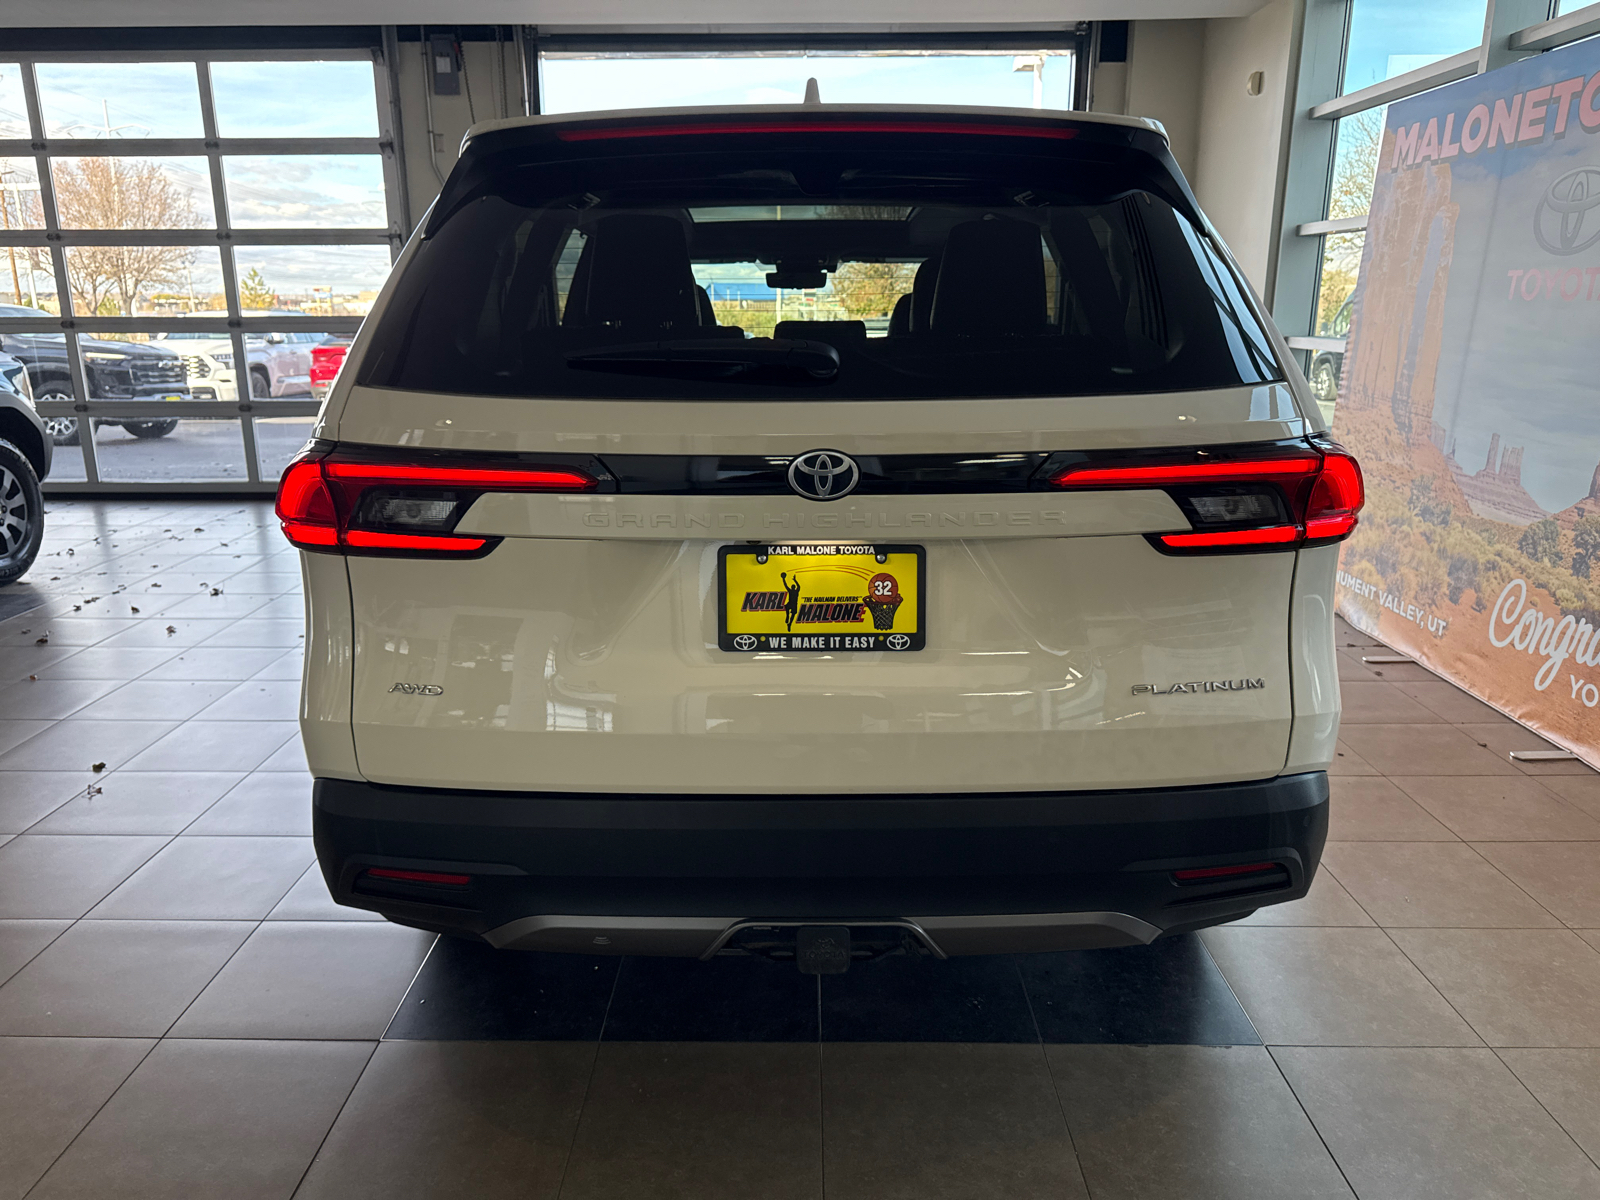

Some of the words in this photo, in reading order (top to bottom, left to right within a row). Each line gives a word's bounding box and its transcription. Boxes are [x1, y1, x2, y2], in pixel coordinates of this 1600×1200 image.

[1507, 266, 1600, 302] TOYOT
[583, 512, 745, 529] GRAND
[763, 510, 1067, 529] HIGHLANDER
[767, 546, 794, 555] KARL
[796, 546, 838, 555] MALONE
[839, 546, 875, 555] TOYOTA
[874, 581, 892, 596] 32
[741, 591, 788, 612] KARL
[796, 603, 866, 623] MALONE
[1379, 590, 1424, 629] VALLEY,
[1427, 617, 1447, 637] UT
[769, 637, 787, 648] WE
[792, 637, 825, 648] MAKE
[830, 636, 840, 648] IT
[845, 636, 875, 648] EASY
[388, 682, 444, 696] AWD
[1131, 677, 1266, 696] PLATINUM
[1569, 674, 1599, 708] YO
